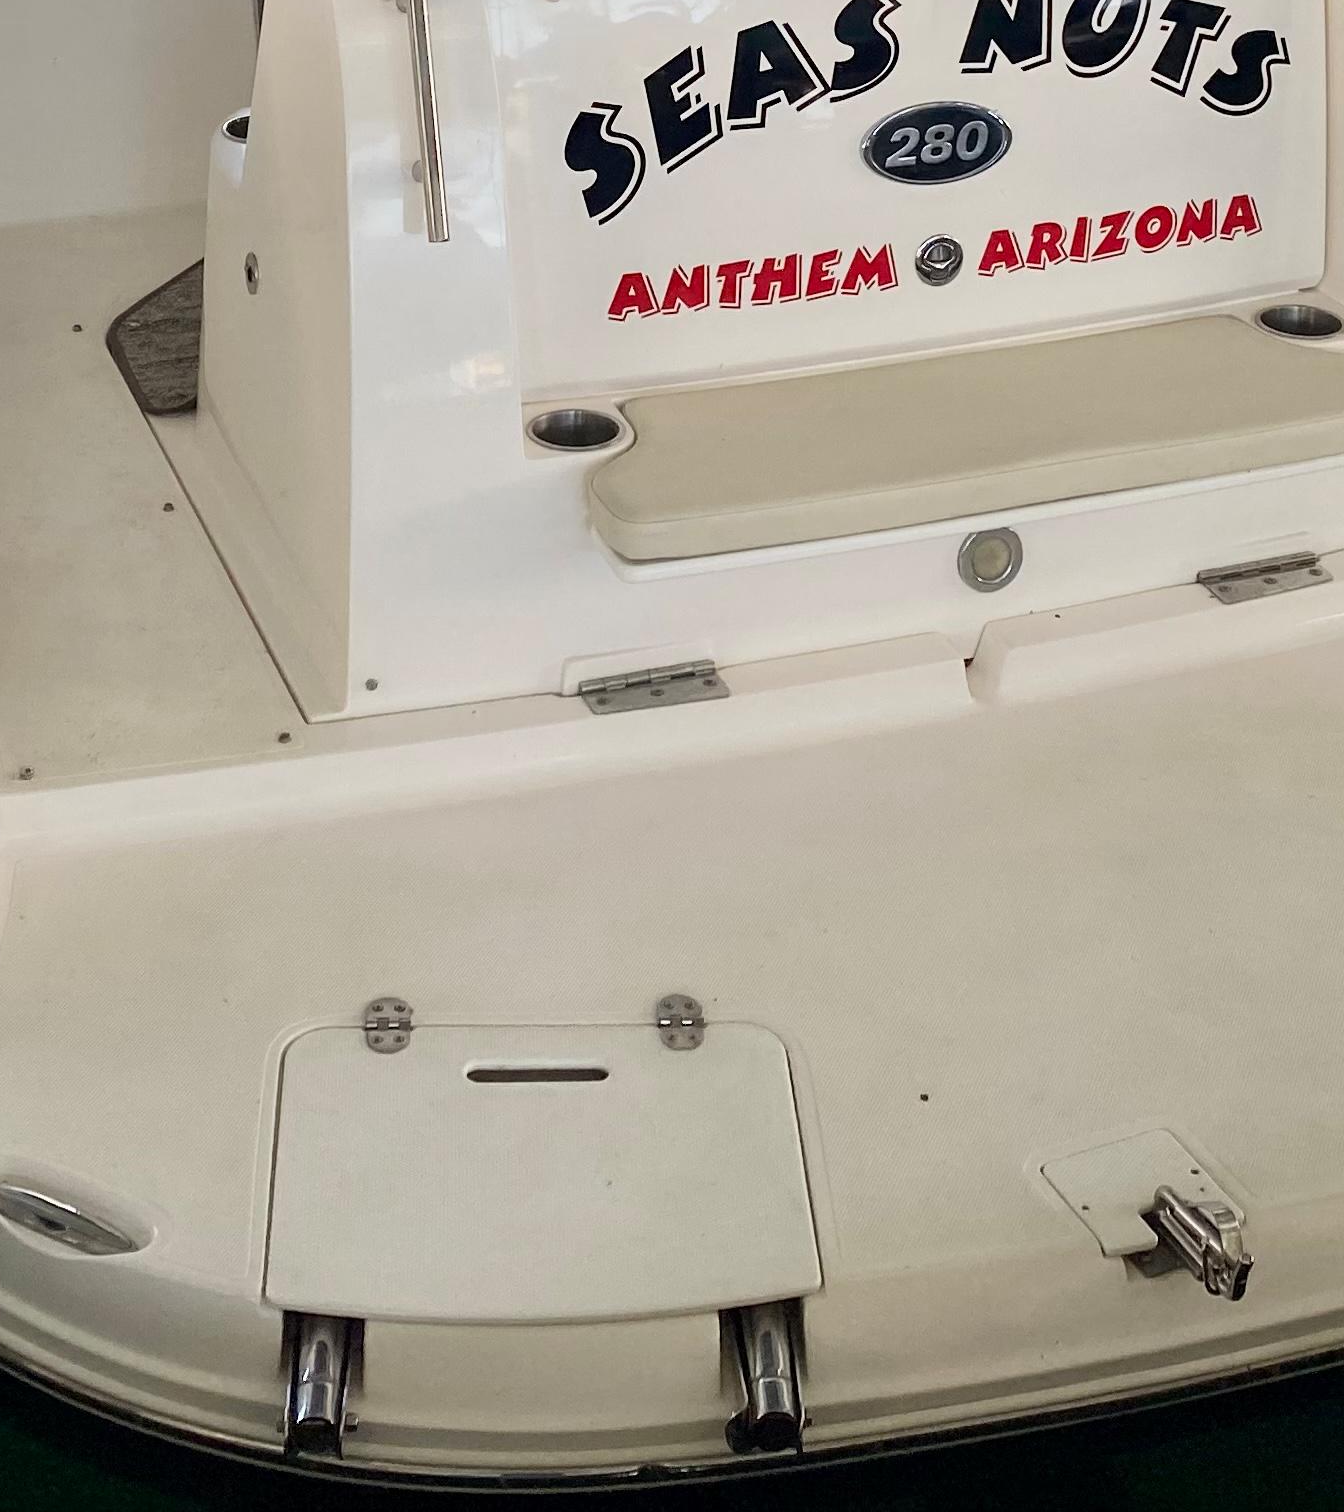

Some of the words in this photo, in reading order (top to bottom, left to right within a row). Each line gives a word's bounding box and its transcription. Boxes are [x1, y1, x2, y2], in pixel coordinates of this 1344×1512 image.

[884, 120, 989, 168] 280
[607, 243, 899, 322] ANTHEM
[977, 194, 1263, 277] ARIZONA
